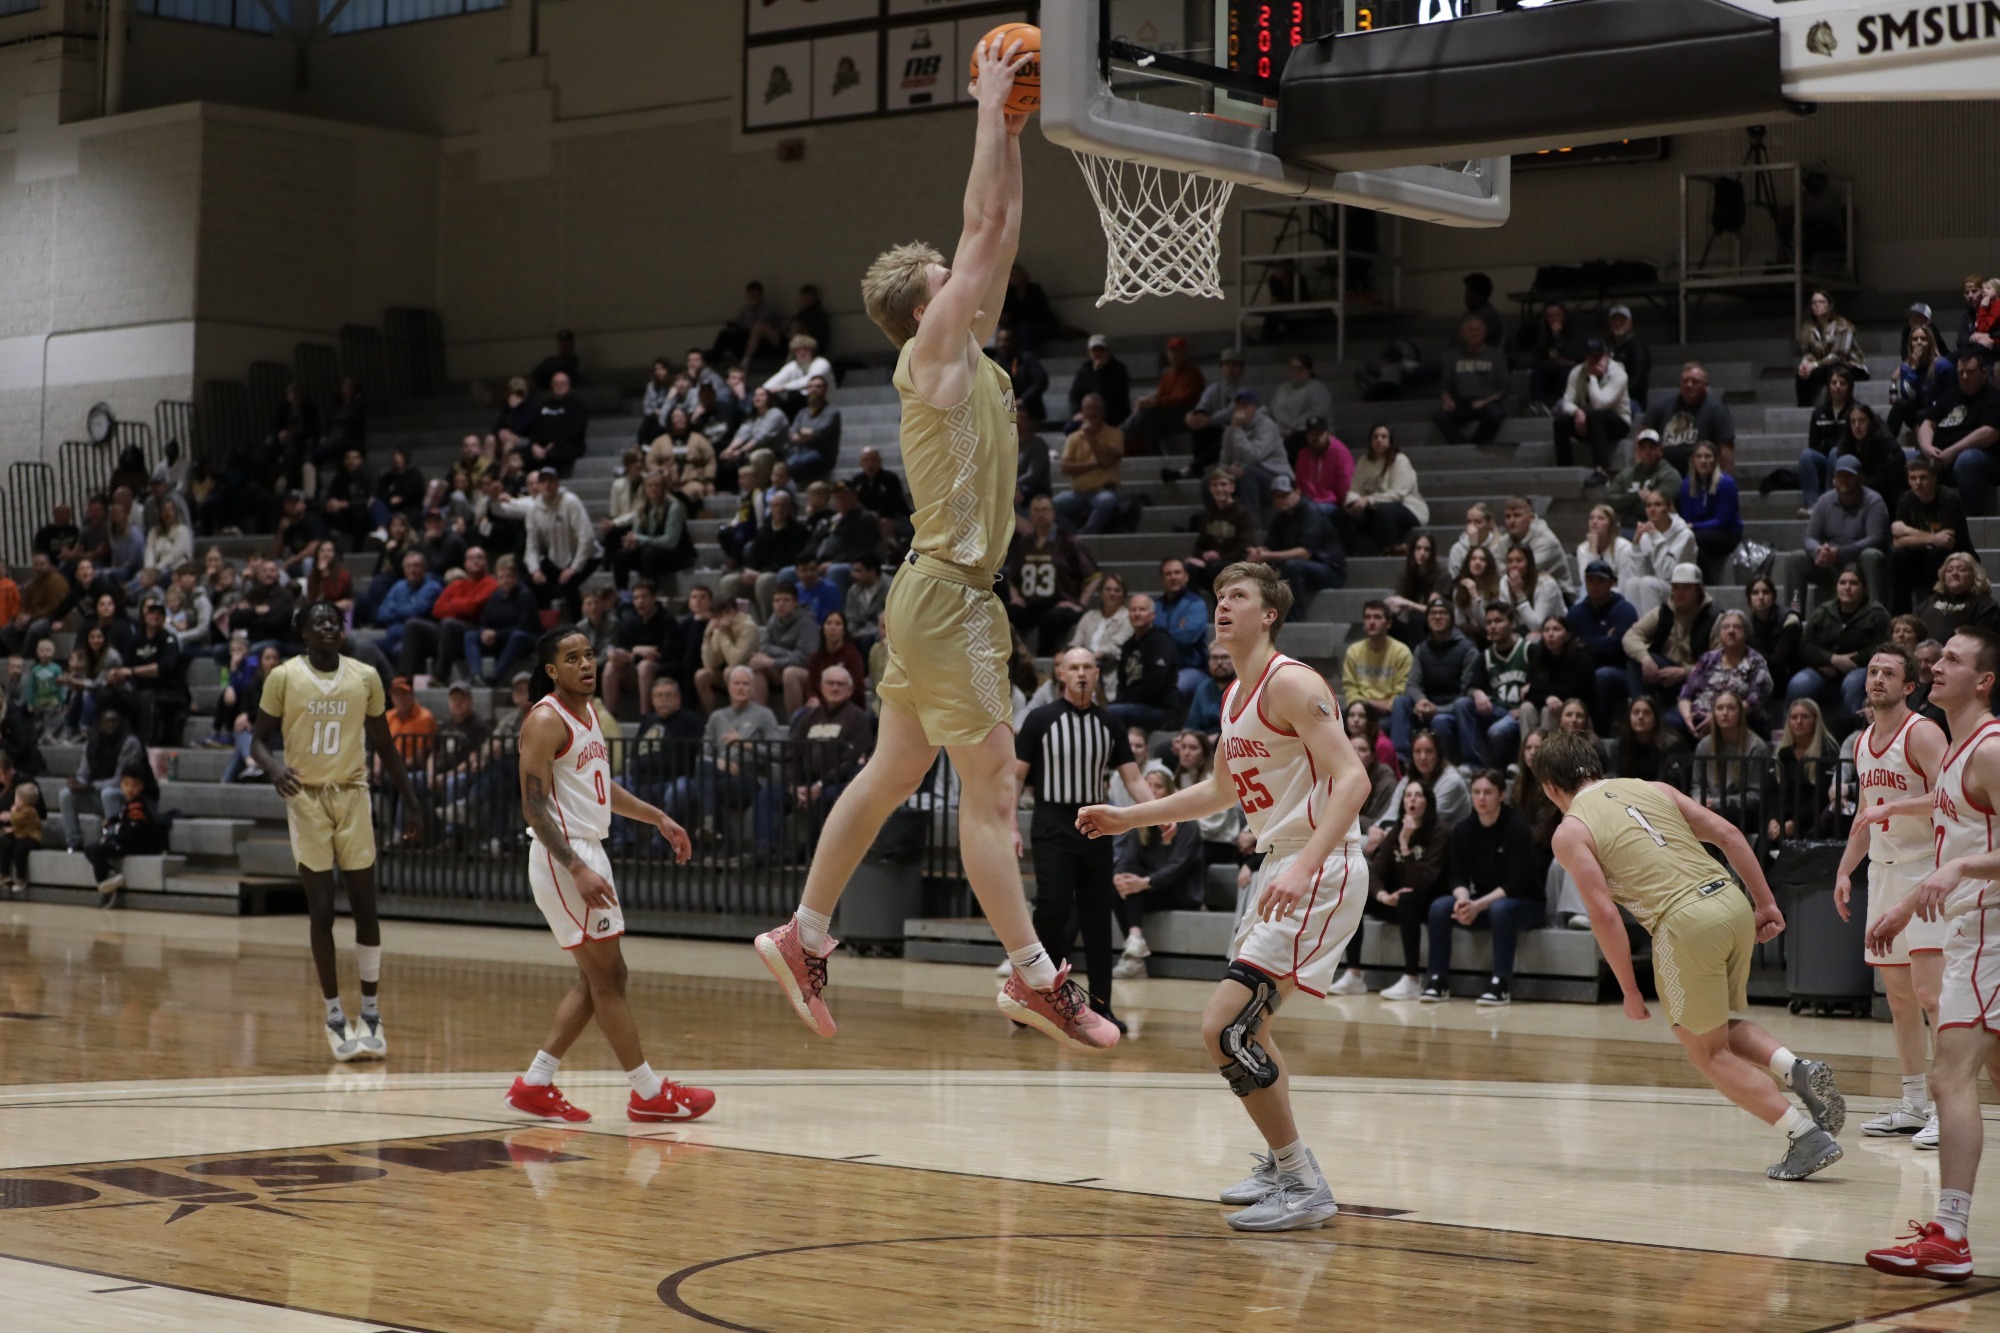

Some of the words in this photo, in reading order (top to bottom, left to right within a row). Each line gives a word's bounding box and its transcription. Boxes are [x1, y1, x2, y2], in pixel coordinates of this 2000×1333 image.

[1021, 563, 1056, 597] 83
[307, 700, 348, 716] SMSU
[311, 720, 342, 756] 10
[1223, 736, 1271, 761] AGONS
[594, 770, 606, 806] 0
[1231, 766, 1274, 814] 25
[1860, 768, 1908, 791] RAGONS
[1625, 805, 1668, 847] 1
